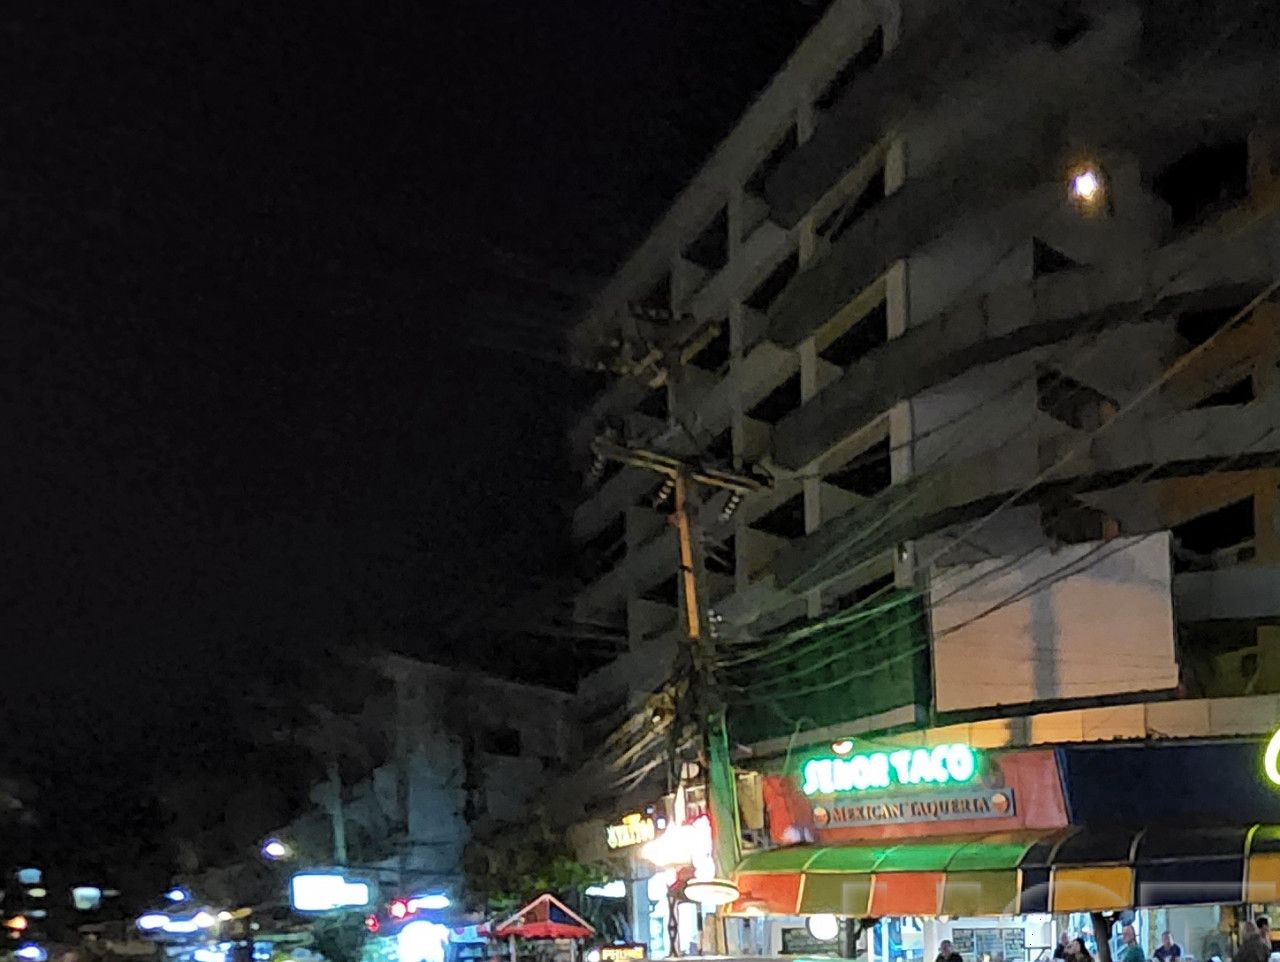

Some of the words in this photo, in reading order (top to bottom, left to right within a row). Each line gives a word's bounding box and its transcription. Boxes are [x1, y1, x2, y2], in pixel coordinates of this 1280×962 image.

[890, 743, 974, 784] TACO
[832, 802, 903, 823] MEXICAN
[904, 796, 991, 819] TAQUERIA
